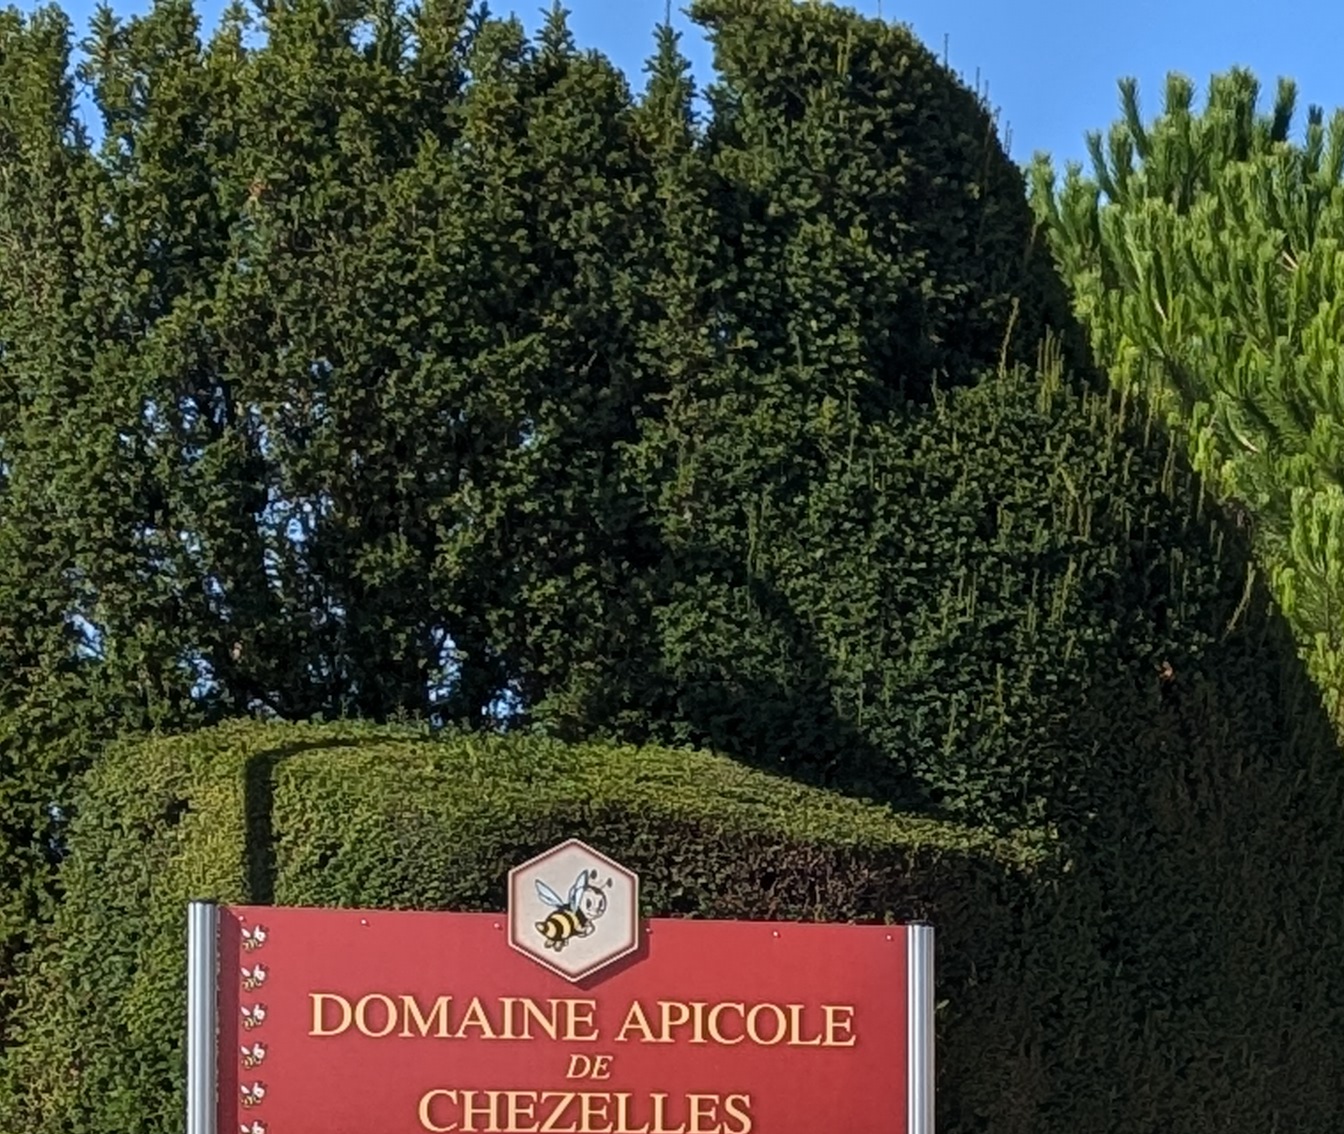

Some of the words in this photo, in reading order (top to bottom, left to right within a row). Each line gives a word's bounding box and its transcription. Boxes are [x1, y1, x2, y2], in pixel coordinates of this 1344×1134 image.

[308, 993, 599, 1042] DOMAINE
[614, 1000, 857, 1048] APICOLE
[567, 1054, 614, 1081] DE
